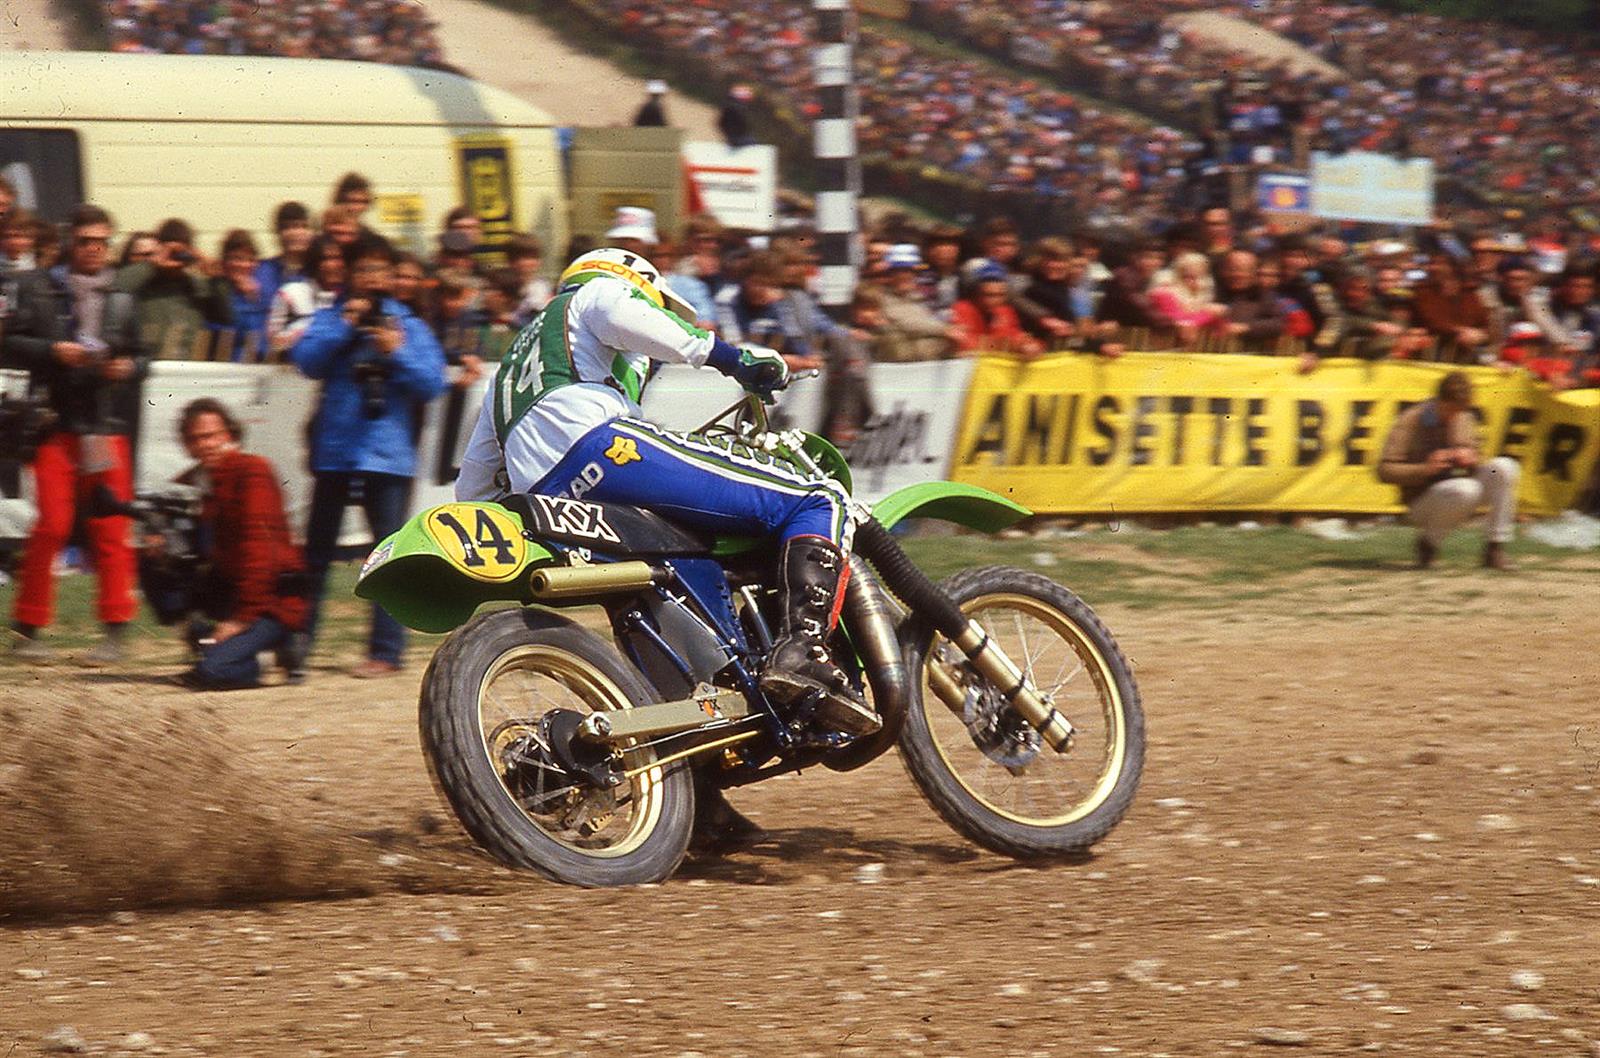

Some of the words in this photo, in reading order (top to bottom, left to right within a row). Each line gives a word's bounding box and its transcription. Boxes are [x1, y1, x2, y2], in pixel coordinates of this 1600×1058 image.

[581, 260, 648, 288] SCOTT
[503, 335, 545, 426] 14
[962, 394, 1268, 467] ANISETTE
[1294, 399, 1586, 482] BEER
[559, 461, 605, 500] AD
[435, 509, 517, 567] 14
[534, 494, 622, 543] KX
